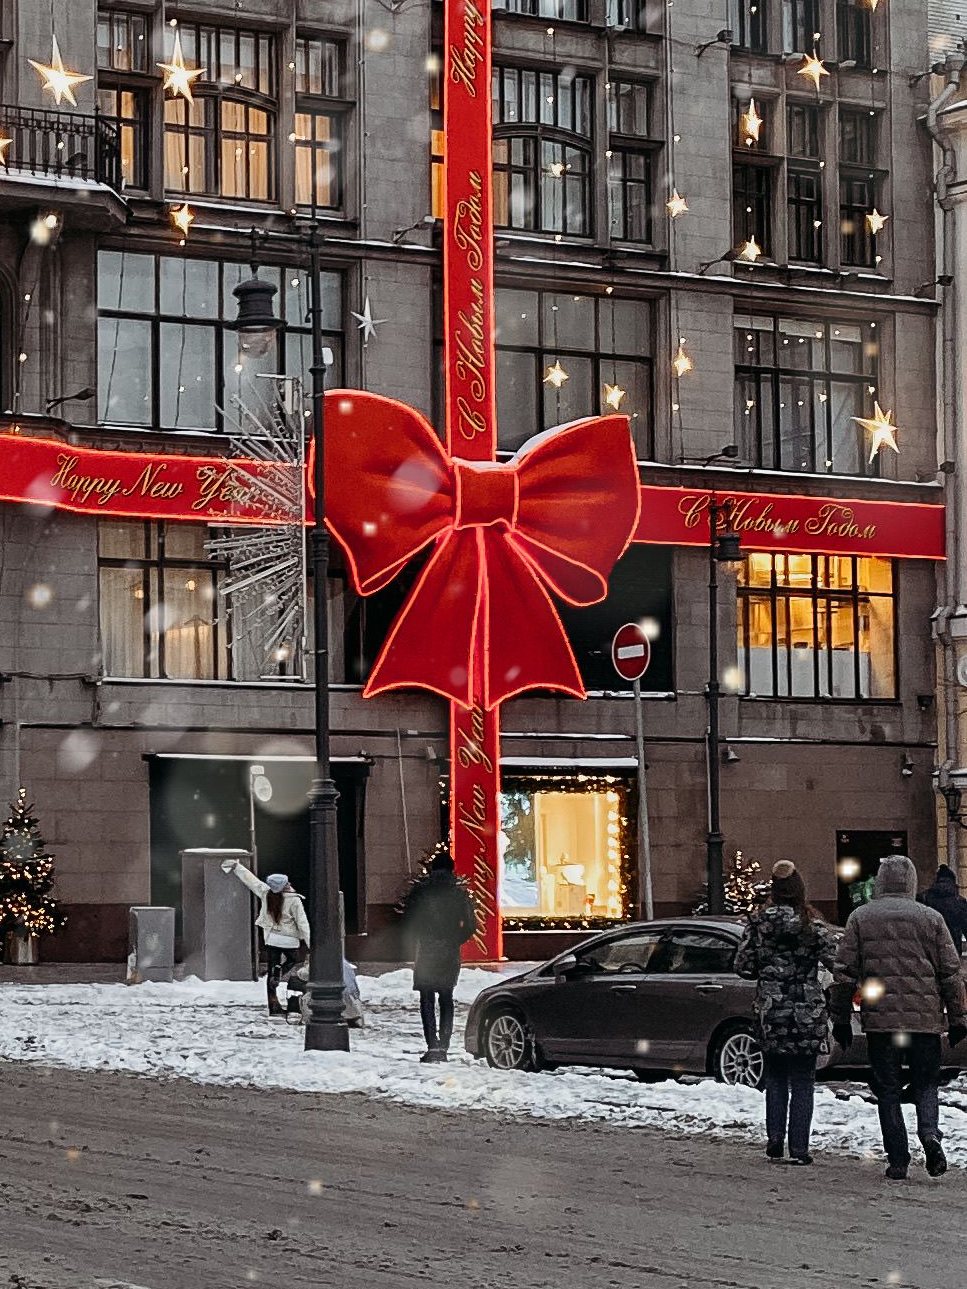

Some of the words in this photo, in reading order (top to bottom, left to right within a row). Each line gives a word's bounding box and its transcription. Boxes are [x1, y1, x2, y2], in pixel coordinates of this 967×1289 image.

[450, 0, 484, 98] Happy
[453, 169, 483, 272] Годом
[455, 277, 486, 402] Новым
[457, 397, 487, 441] С
[51, 452, 122, 505] Happy
[122, 463, 184, 498] New
[678, 495, 711, 528] С
[804, 503, 877, 540] Годом
[458, 783, 487, 853] New
